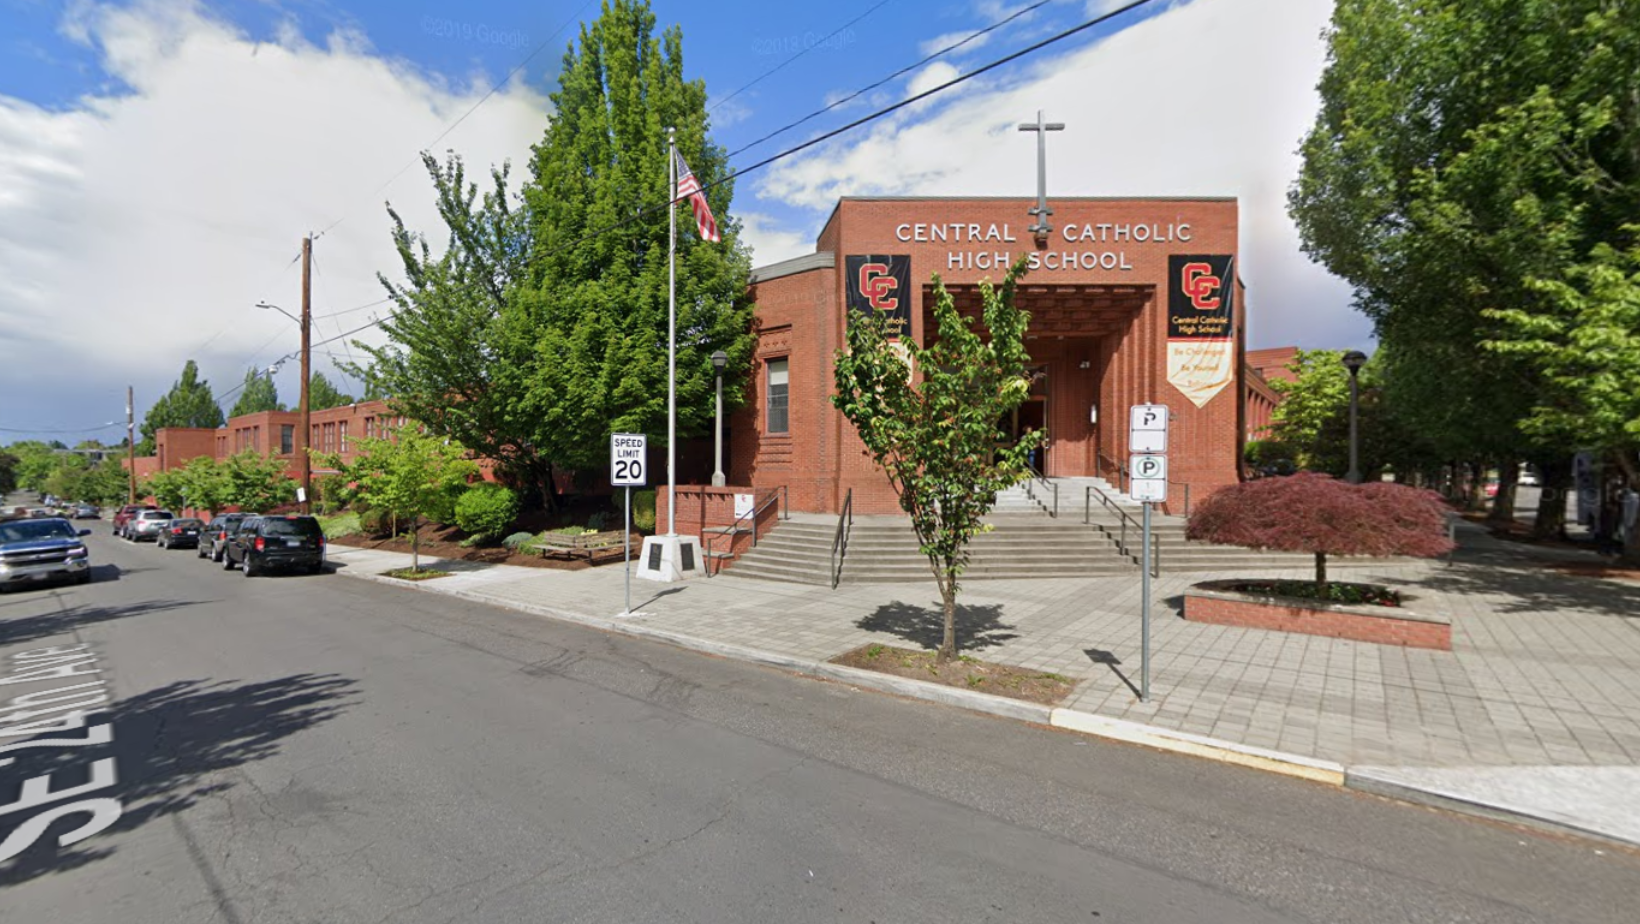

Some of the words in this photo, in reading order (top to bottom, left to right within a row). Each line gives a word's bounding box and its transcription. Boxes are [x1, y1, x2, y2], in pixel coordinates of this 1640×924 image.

[896, 223, 1017, 242] CENTRAL
[1062, 223, 1192, 242] CATHOLIC
[947, 251, 1010, 270] HIGH
[1027, 251, 1133, 270] SCHOOL
[1171, 315, 1199, 325] Central
[1200, 315, 1229, 325] Catholic
[1178, 325, 1197, 335] High
[1198, 325, 1223, 334] School
[614, 438, 643, 448] SPEED
[617, 449, 640, 458] LIMIT
[615, 460, 642, 480] 20
[1143, 461, 1156, 475] P
